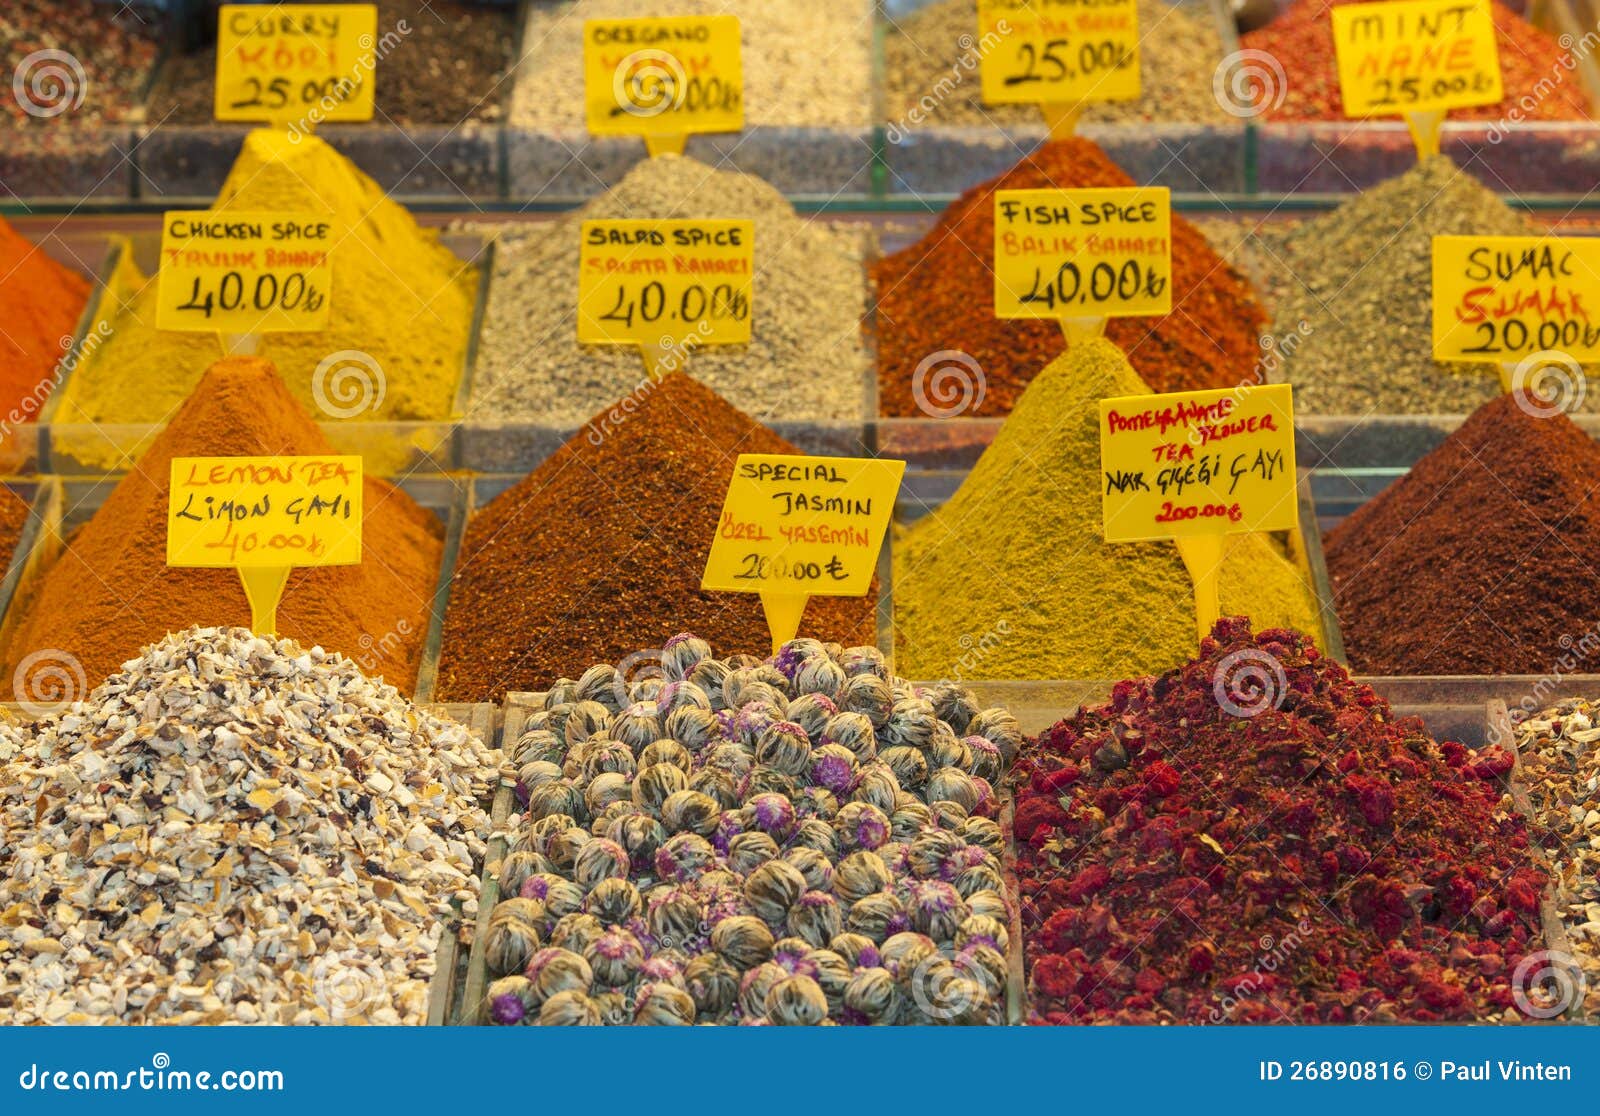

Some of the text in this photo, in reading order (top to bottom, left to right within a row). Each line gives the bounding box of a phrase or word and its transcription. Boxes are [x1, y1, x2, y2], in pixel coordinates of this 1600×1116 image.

[229, 12, 341, 38] CURRY
[592, 25, 710, 46] OREGANO
[1350, 5, 1476, 42] MINT
[1357, 37, 1475, 77] NANE
[1000, 201, 1157, 225] FISH SPICE
[169, 220, 331, 240] CHICKEN SPICE
[587, 227, 742, 246] SALAD SPICE
[1002, 231, 1078, 257] BALIK
[1464, 245, 1573, 282] SUMAC
[1455, 285, 1590, 325] SUMAK
[1151, 443, 1195, 463] TEA
[181, 461, 357, 487] LEMON TEA
[739, 463, 848, 483] SPECIAL
[1105, 469, 1150, 496] NAR
[772, 491, 872, 516] JASMIN
[720, 512, 773, 541] ÖZEL
